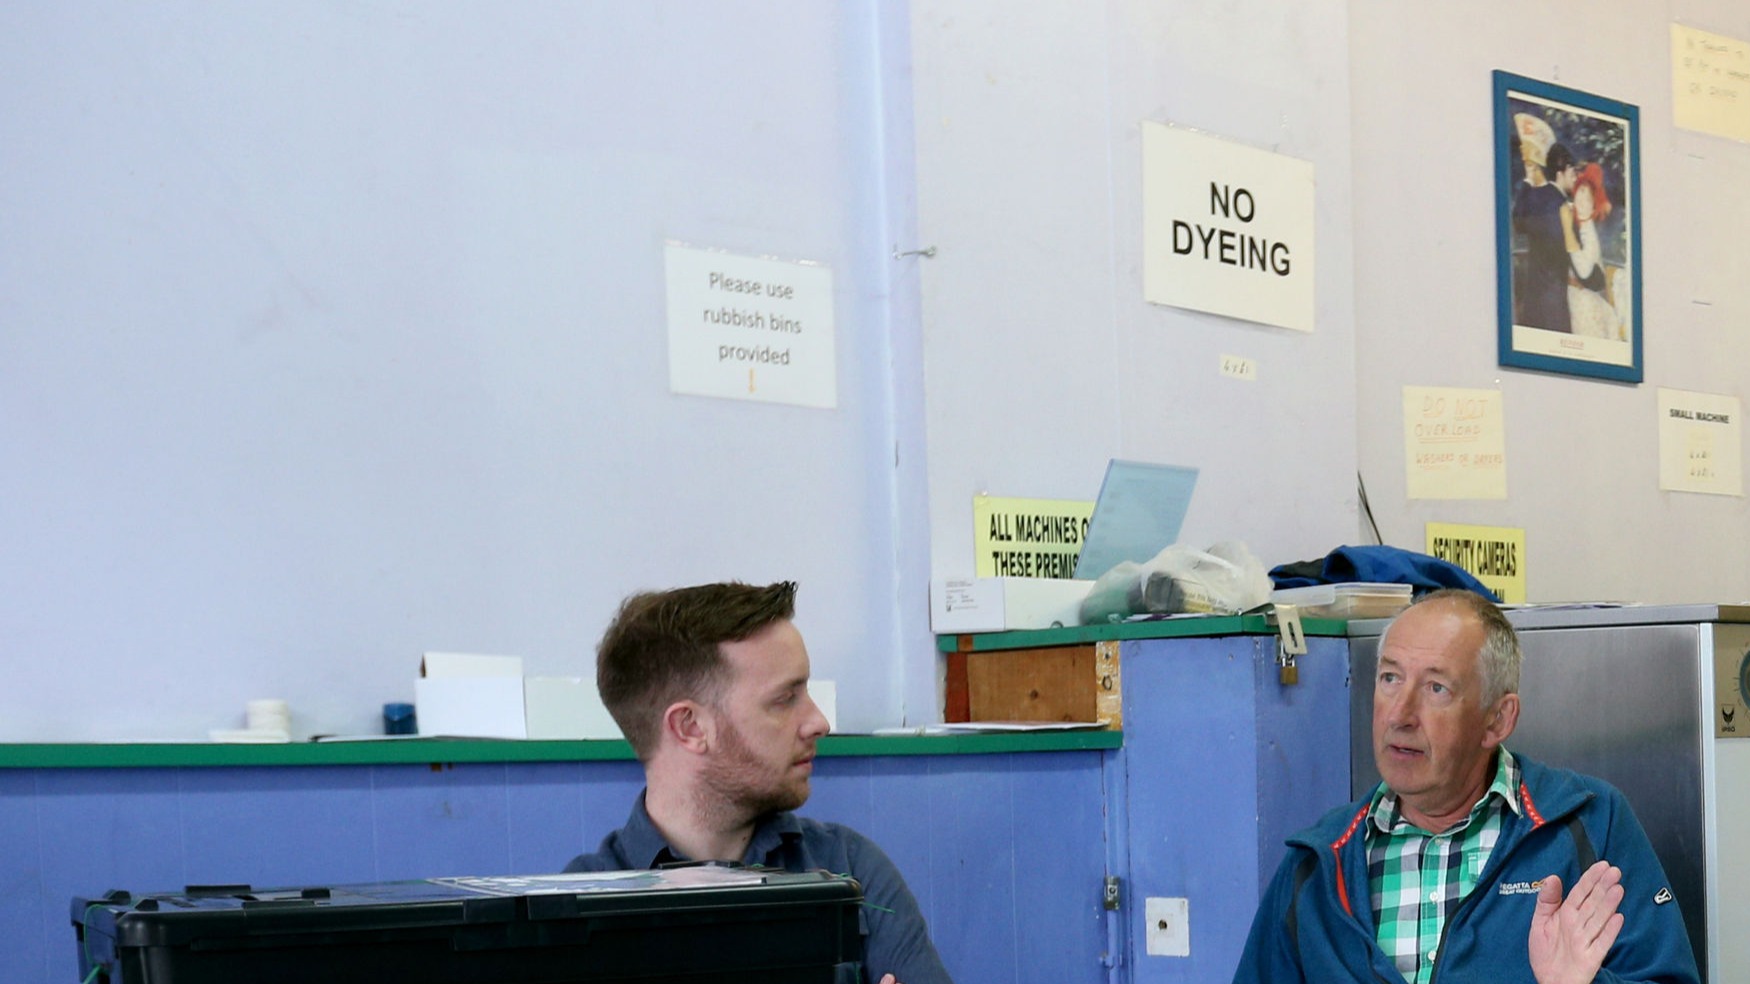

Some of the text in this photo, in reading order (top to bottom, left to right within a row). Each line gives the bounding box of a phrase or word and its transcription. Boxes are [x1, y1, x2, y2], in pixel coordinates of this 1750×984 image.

[1211, 181, 1255, 223] NO
[1172, 219, 1291, 277] DYEING
[709, 271, 794, 300] Please use
[703, 307, 802, 334] rubbish bins
[718, 345, 790, 366] provided
[1669, 408, 1730, 424] SMALL MACHINE
[989, 513, 1012, 541] ALL
[1015, 514, 1078, 544] MACHINES
[992, 551, 1033, 578] THESE
[1477, 540, 1516, 577] CAMERAS
